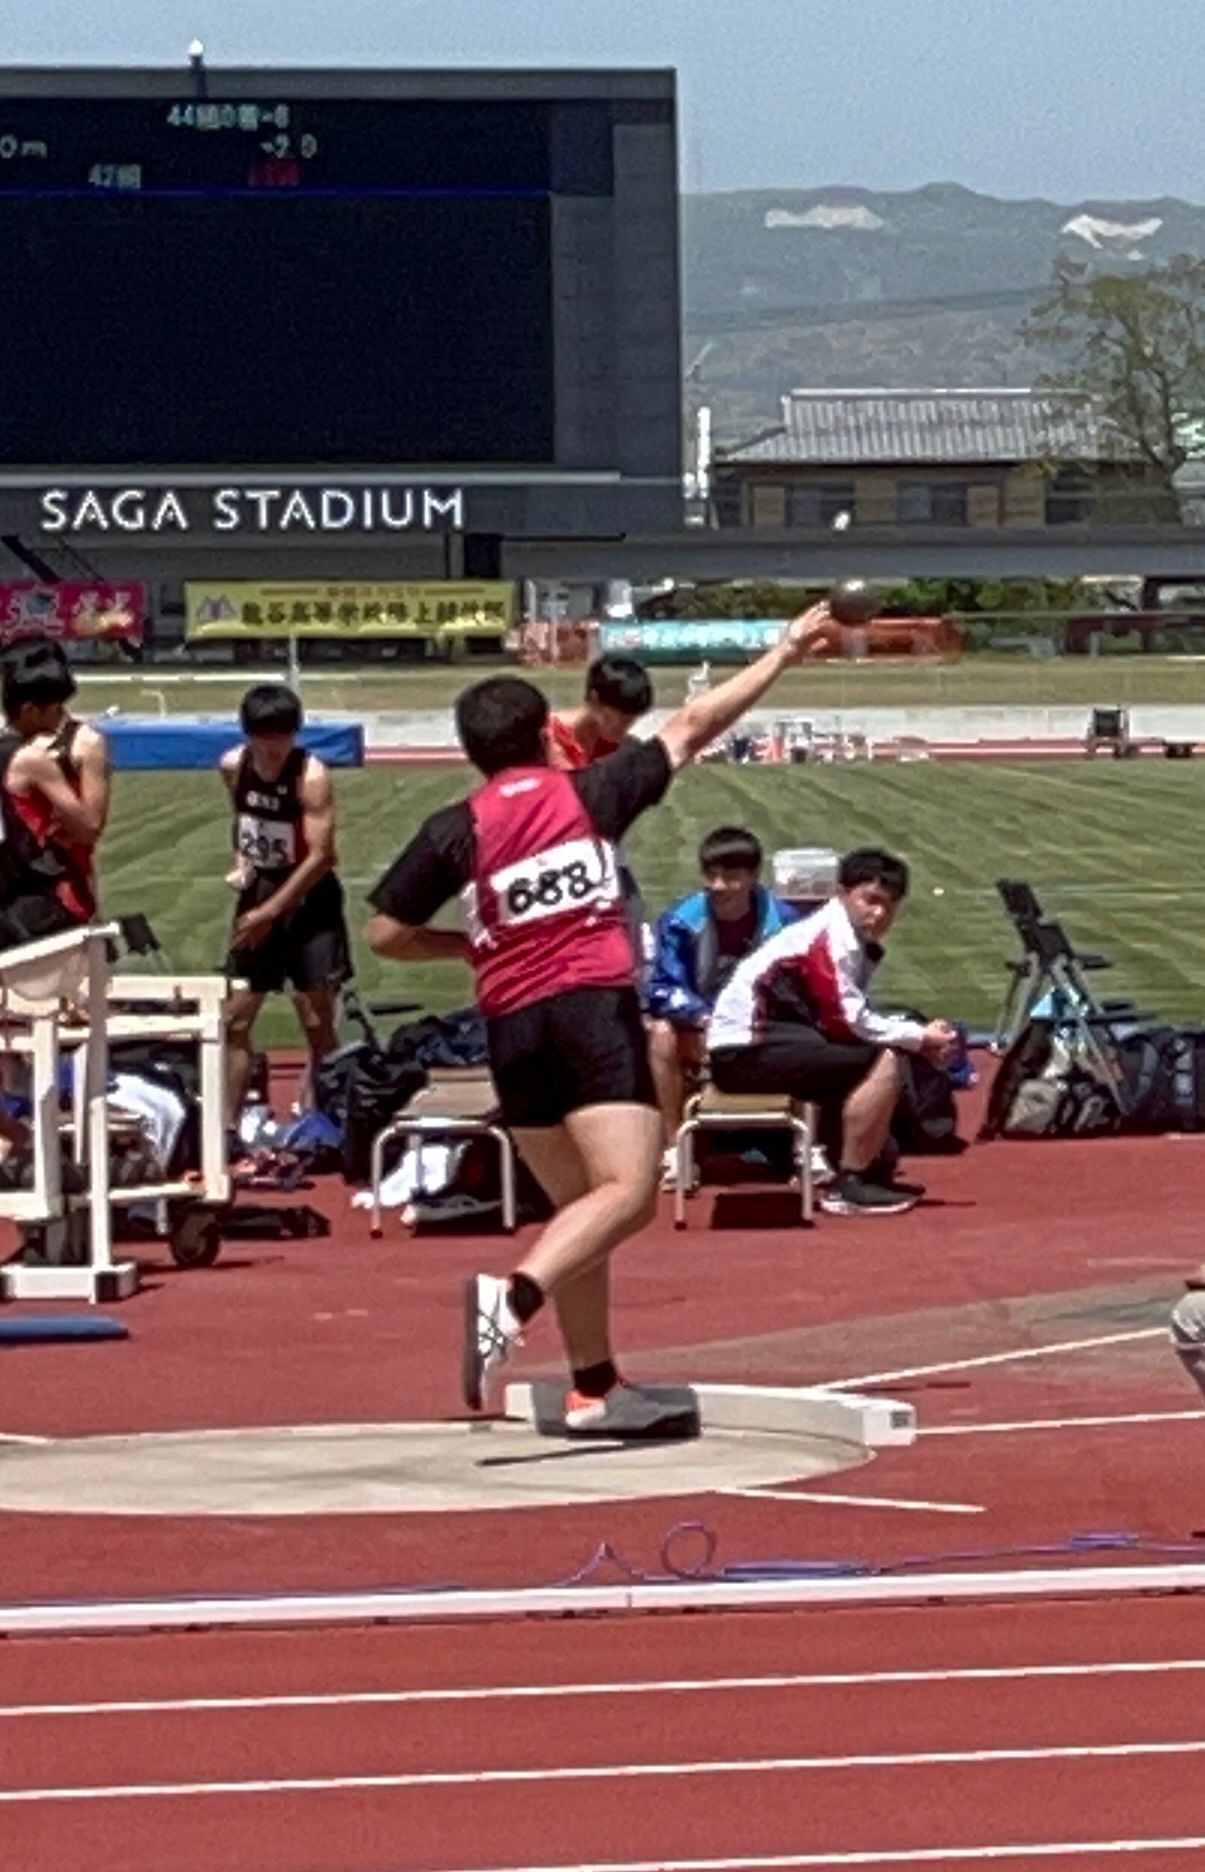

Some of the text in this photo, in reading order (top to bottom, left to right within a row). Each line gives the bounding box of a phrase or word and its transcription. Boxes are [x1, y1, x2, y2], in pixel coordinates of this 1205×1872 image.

[41, 489, 465, 530] SAGA STADIUM
[507, 861, 597, 915] 688
